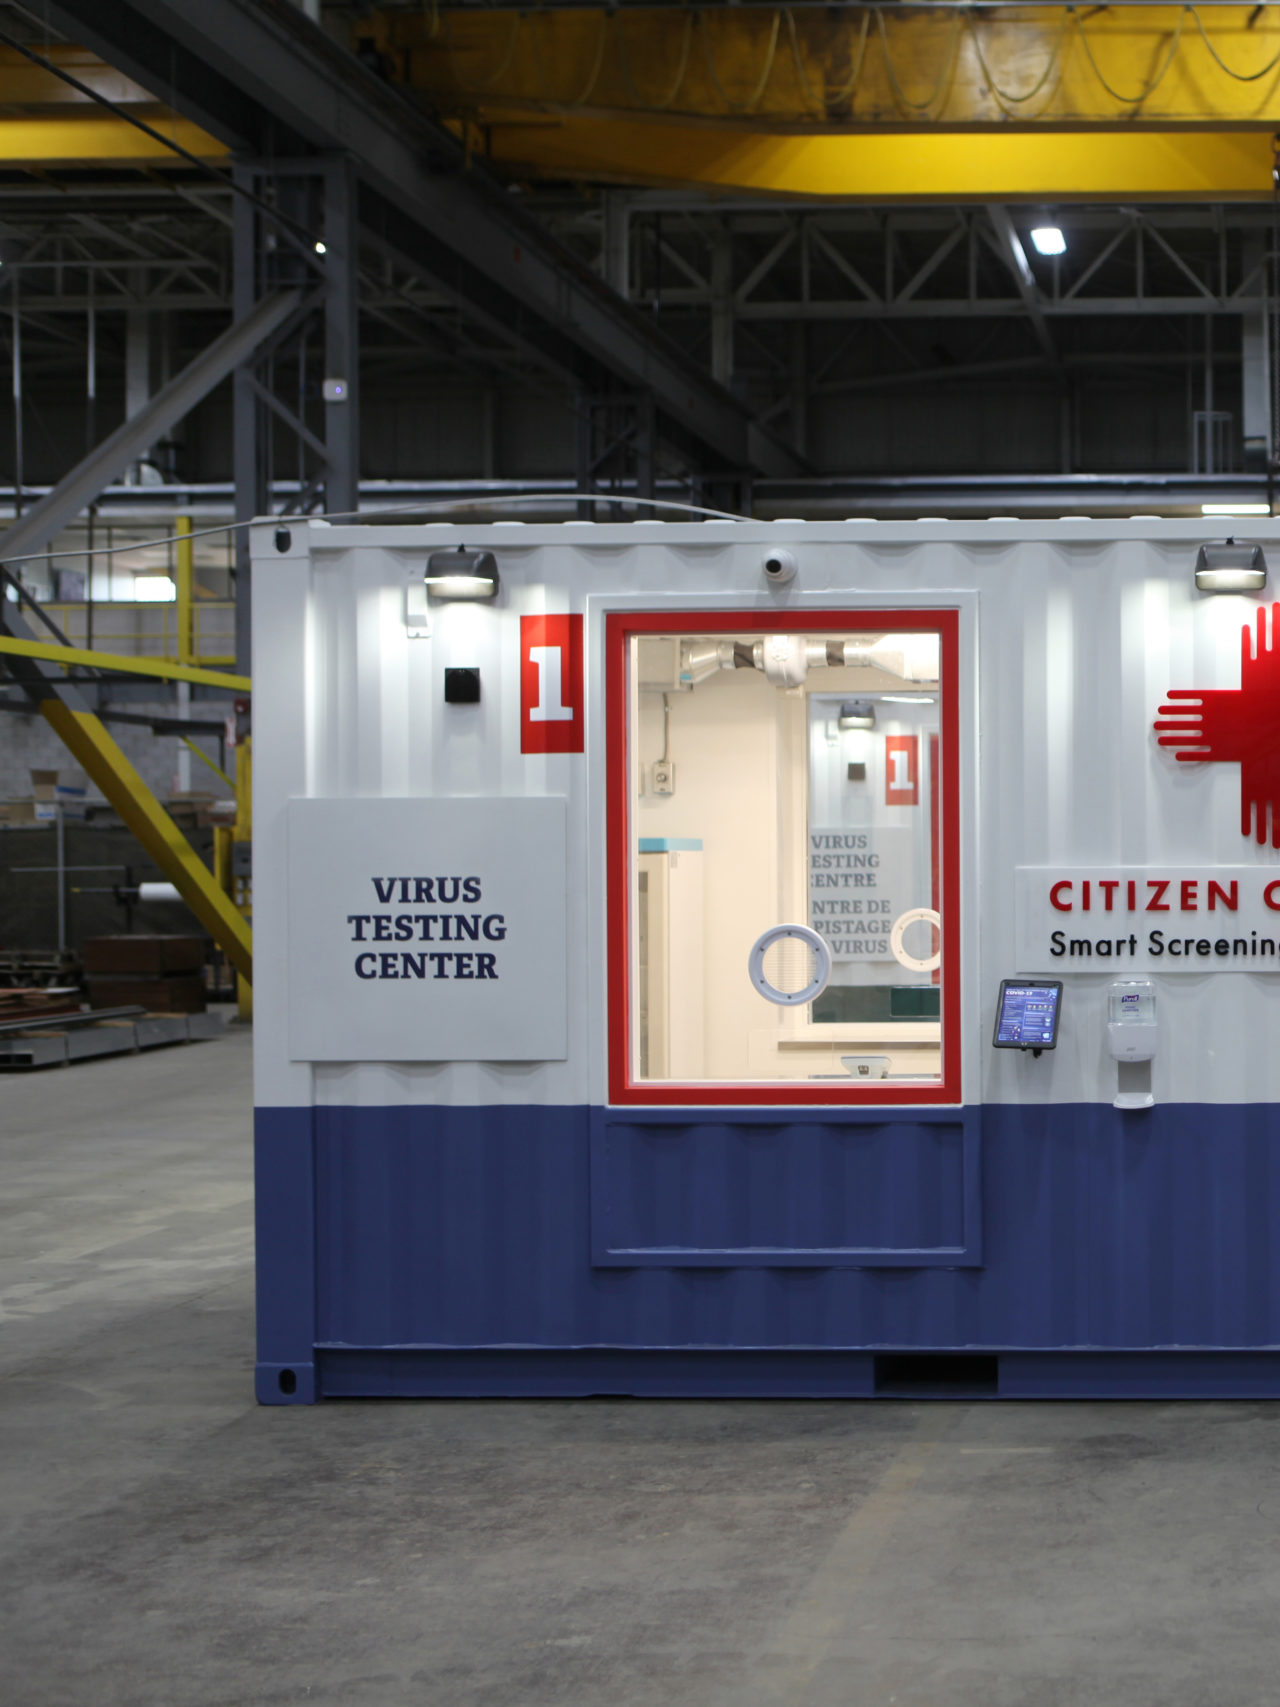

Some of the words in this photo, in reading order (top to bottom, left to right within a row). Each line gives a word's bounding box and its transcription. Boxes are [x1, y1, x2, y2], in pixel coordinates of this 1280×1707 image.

[529, 646, 573, 722] 1
[889, 750, 914, 790] 1
[811, 834, 867, 849] VIRUS
[811, 854, 880, 868] ESTING
[371, 876, 482, 904] VIRUS
[811, 873, 877, 888] ENTRE
[811, 900, 863, 914] NTRE
[867, 900, 891, 914] DE
[1049, 880, 1239, 911] CITIZEN
[347, 914, 507, 942] TESTING
[813, 920, 891, 934] PISTAGE
[831, 940, 888, 954] VIRUS
[1049, 931, 1138, 957] Smart
[355, 953, 499, 980] CENTER
